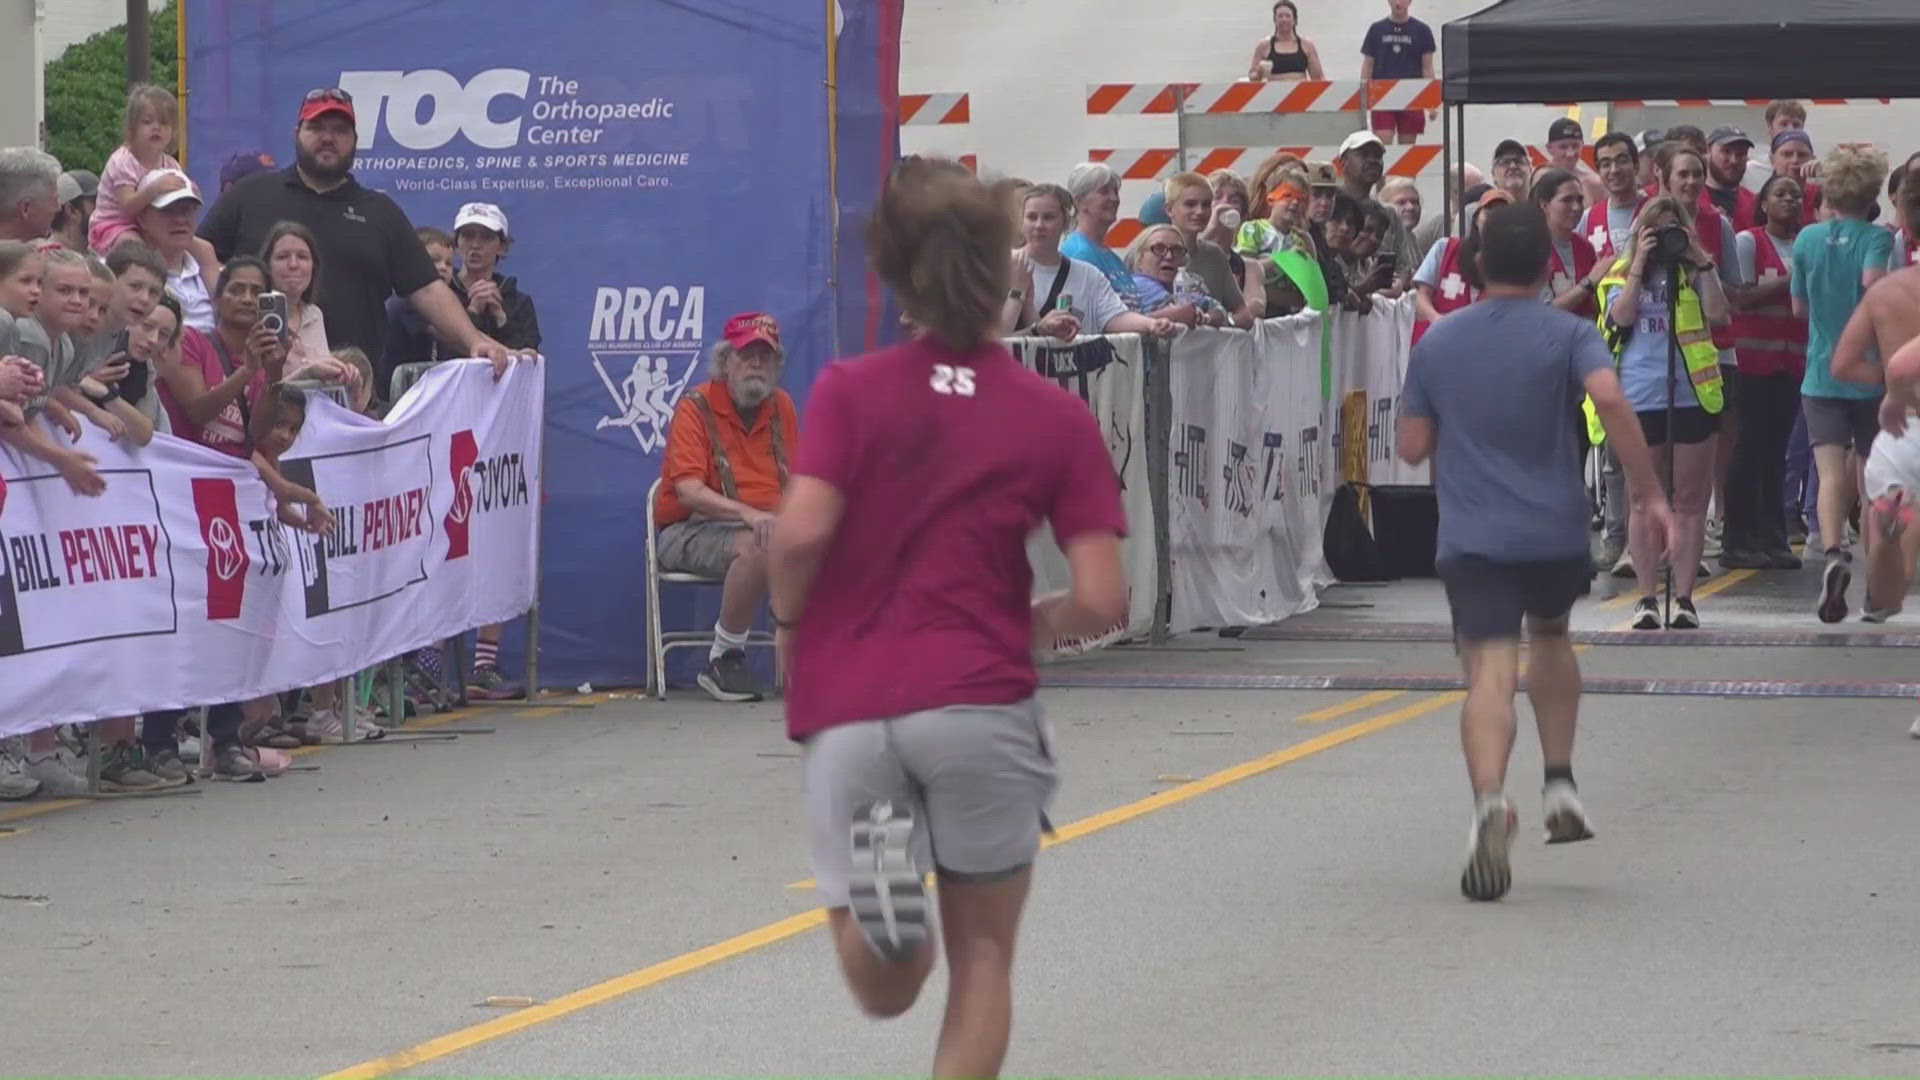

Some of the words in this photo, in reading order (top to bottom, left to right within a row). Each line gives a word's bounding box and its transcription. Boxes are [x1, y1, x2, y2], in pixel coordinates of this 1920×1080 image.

[538, 75, 579, 96] The
[338, 67, 531, 150] TOC
[532, 98, 674, 124] Orthopaedic
[527, 125, 603, 145] Center
[351, 156, 470, 171] RTHOPAEDICS,
[475, 156, 522, 169] SPINE
[527, 155, 538, 168] &
[544, 154, 607, 168] SPORTS
[613, 152, 690, 167] MEDICINE
[395, 177, 478, 192] World-Class
[482, 176, 549, 191] Expertise,
[554, 174, 633, 190] Exceptional
[589, 285, 705, 341] RRCA
[929, 363, 977, 397] 25
[474, 452, 528, 514] TOYOTA
[362, 486, 429, 552] PENNEY
[9, 533, 61, 592] BILL
[58, 524, 158, 585] PENNEY
